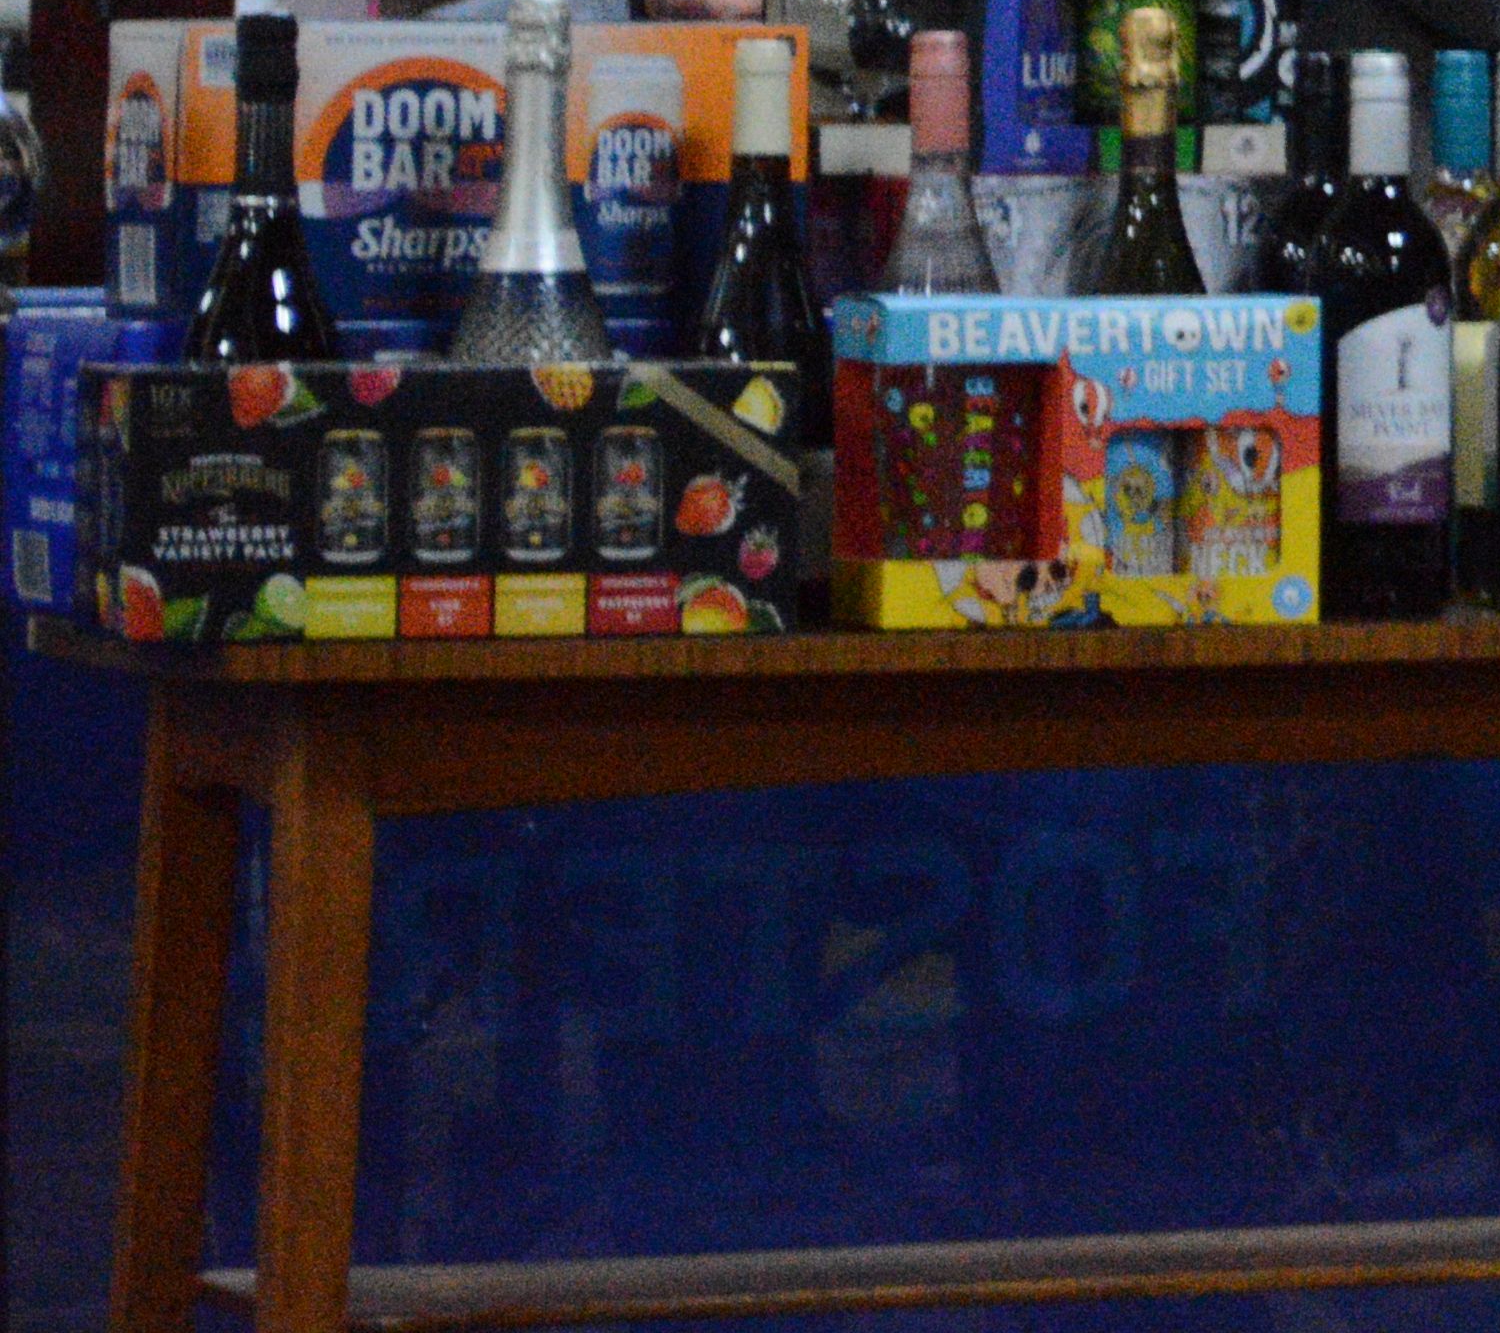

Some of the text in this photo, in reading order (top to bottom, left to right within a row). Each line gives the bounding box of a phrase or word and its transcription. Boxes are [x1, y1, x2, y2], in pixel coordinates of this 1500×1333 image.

[352, 87, 497, 141] DOOM
[597, 127, 677, 159] DOOM
[352, 139, 458, 192] BAR
[597, 156, 653, 189] BAR
[927, 310, 1286, 358] BEAVERTOWN
[1144, 360, 1248, 394] GIFT SET
[157, 525, 290, 543] STRAWBERRY
[152, 542, 295, 562] VARIETY PACK
